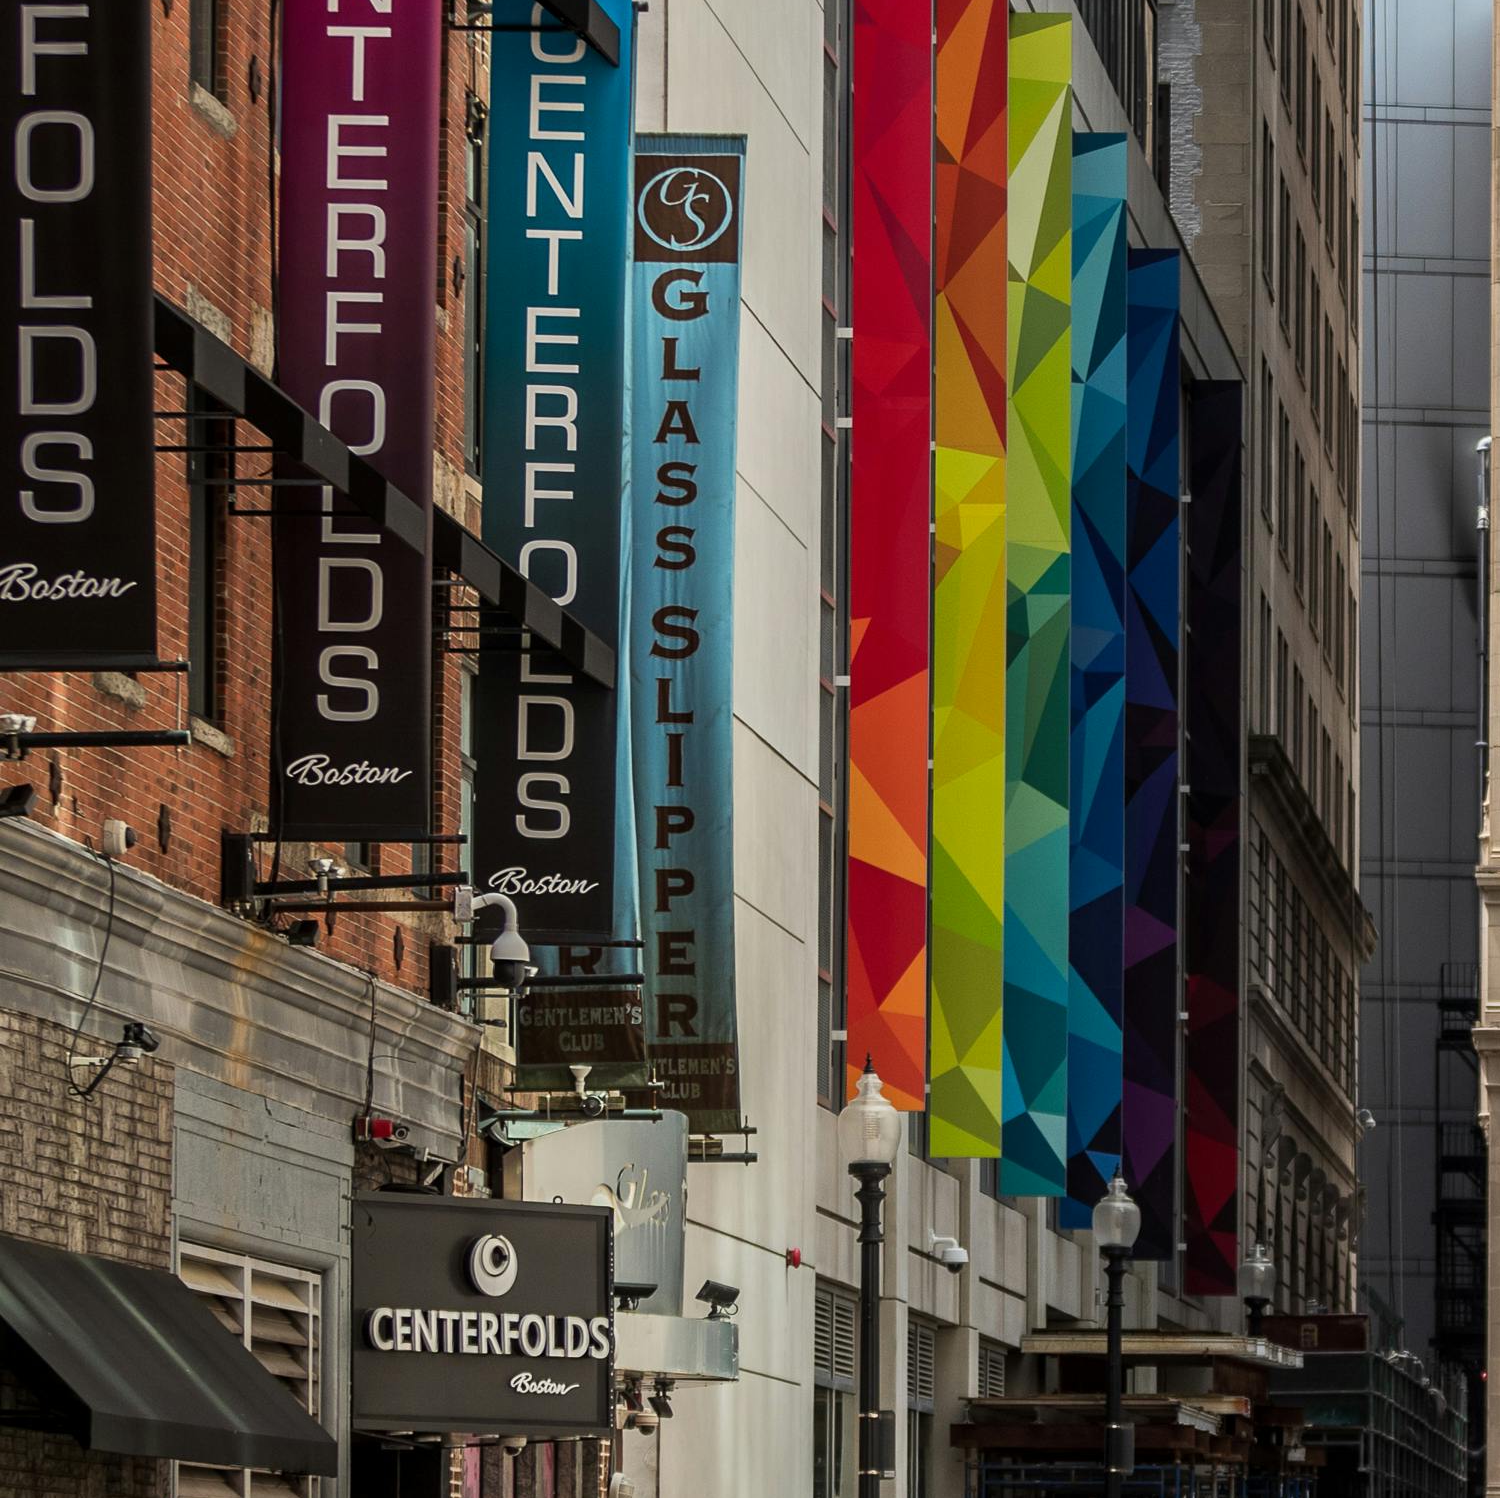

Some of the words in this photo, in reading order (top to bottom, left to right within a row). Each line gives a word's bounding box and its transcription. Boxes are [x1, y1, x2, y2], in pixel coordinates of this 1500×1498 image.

[650, 268, 709, 572] GLASS
[0, 562, 137, 601] Boston
[287, 753, 412, 788] Boston
[648, 606, 703, 1039] SLIPPER
[488, 866, 600, 900] Boston
[519, 1004, 642, 1028] GENTLEMEN'S
[559, 1031, 605, 1052] CLUB
[660, 1082, 701, 1100] CLUB
[367, 1307, 612, 1360] CENTERFOLDS
[510, 1372, 581, 1397] Boston
